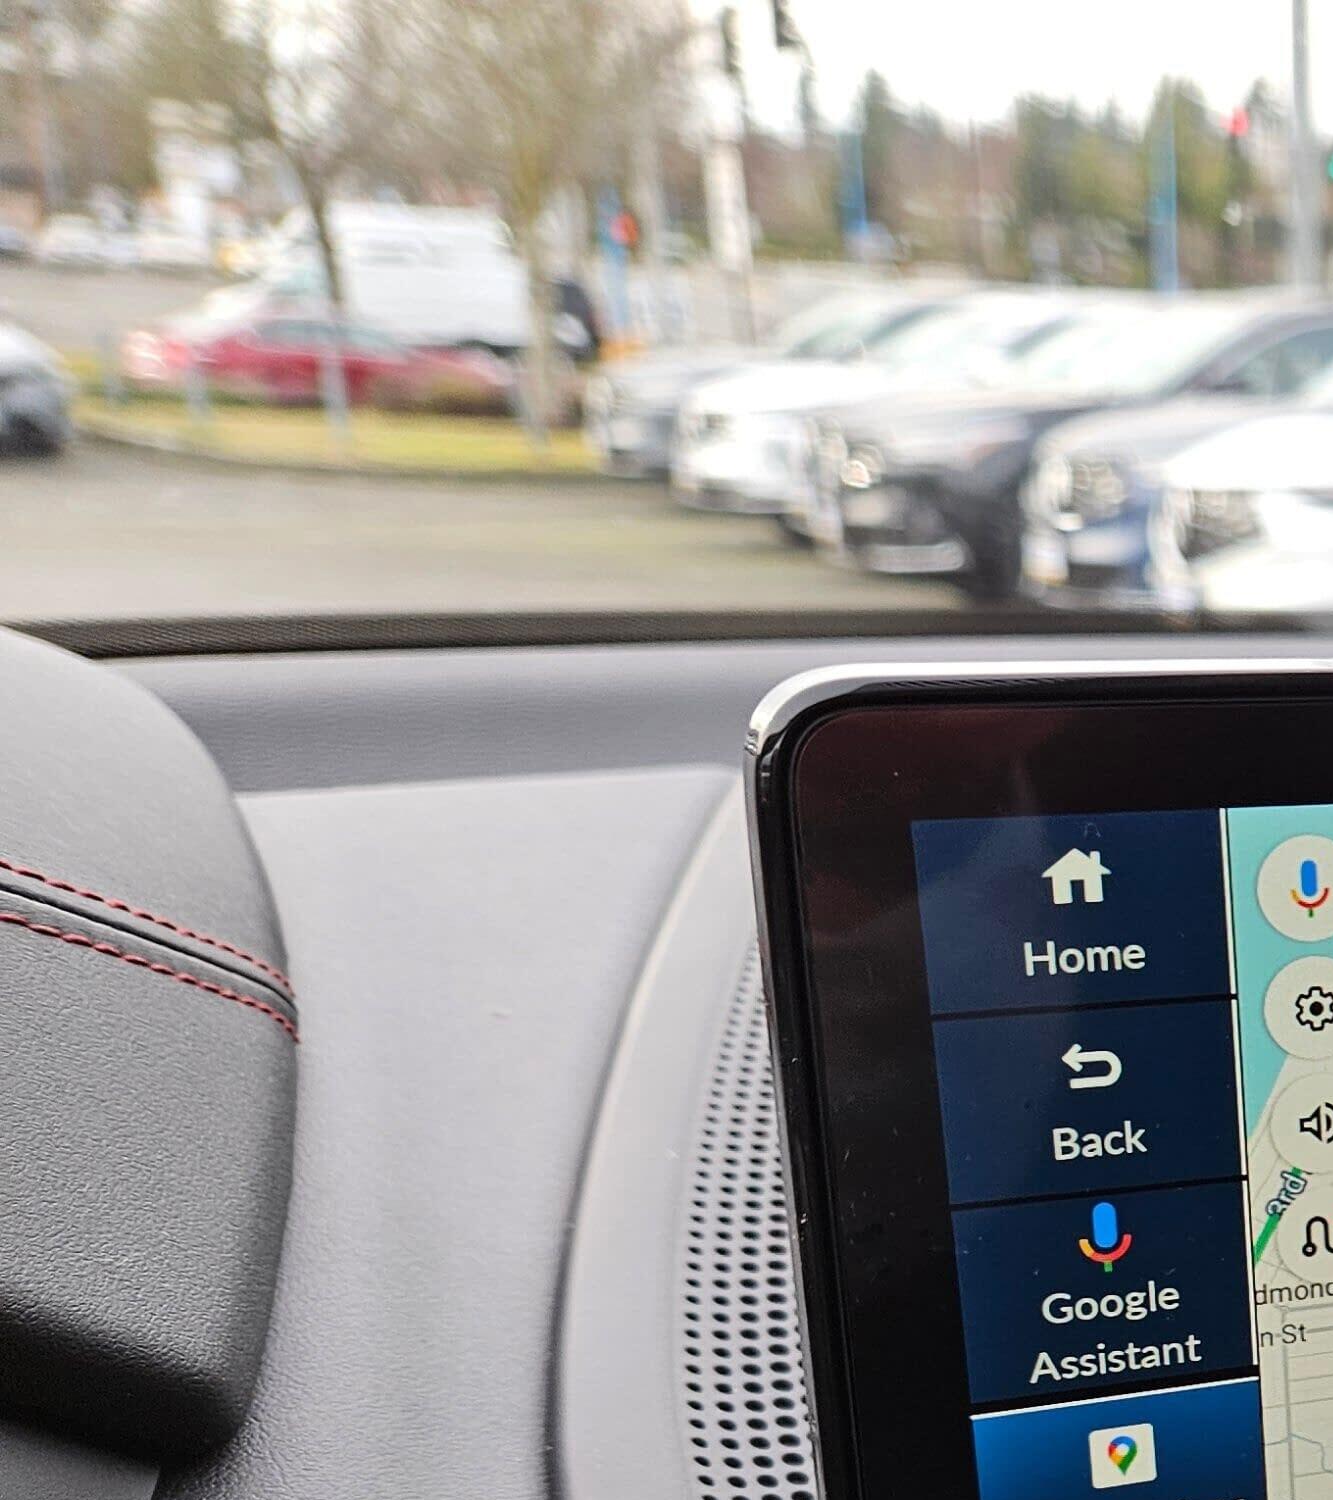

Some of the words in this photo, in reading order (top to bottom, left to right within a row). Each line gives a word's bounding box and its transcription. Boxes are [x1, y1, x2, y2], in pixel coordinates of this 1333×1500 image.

[1023, 939, 1146, 976] Home
[1053, 1120, 1148, 1161] Back
[1041, 1281, 1180, 1323] Google
[1282, 1323, 1306, 1344] St
[1030, 1333, 1201, 1383] Assistant
